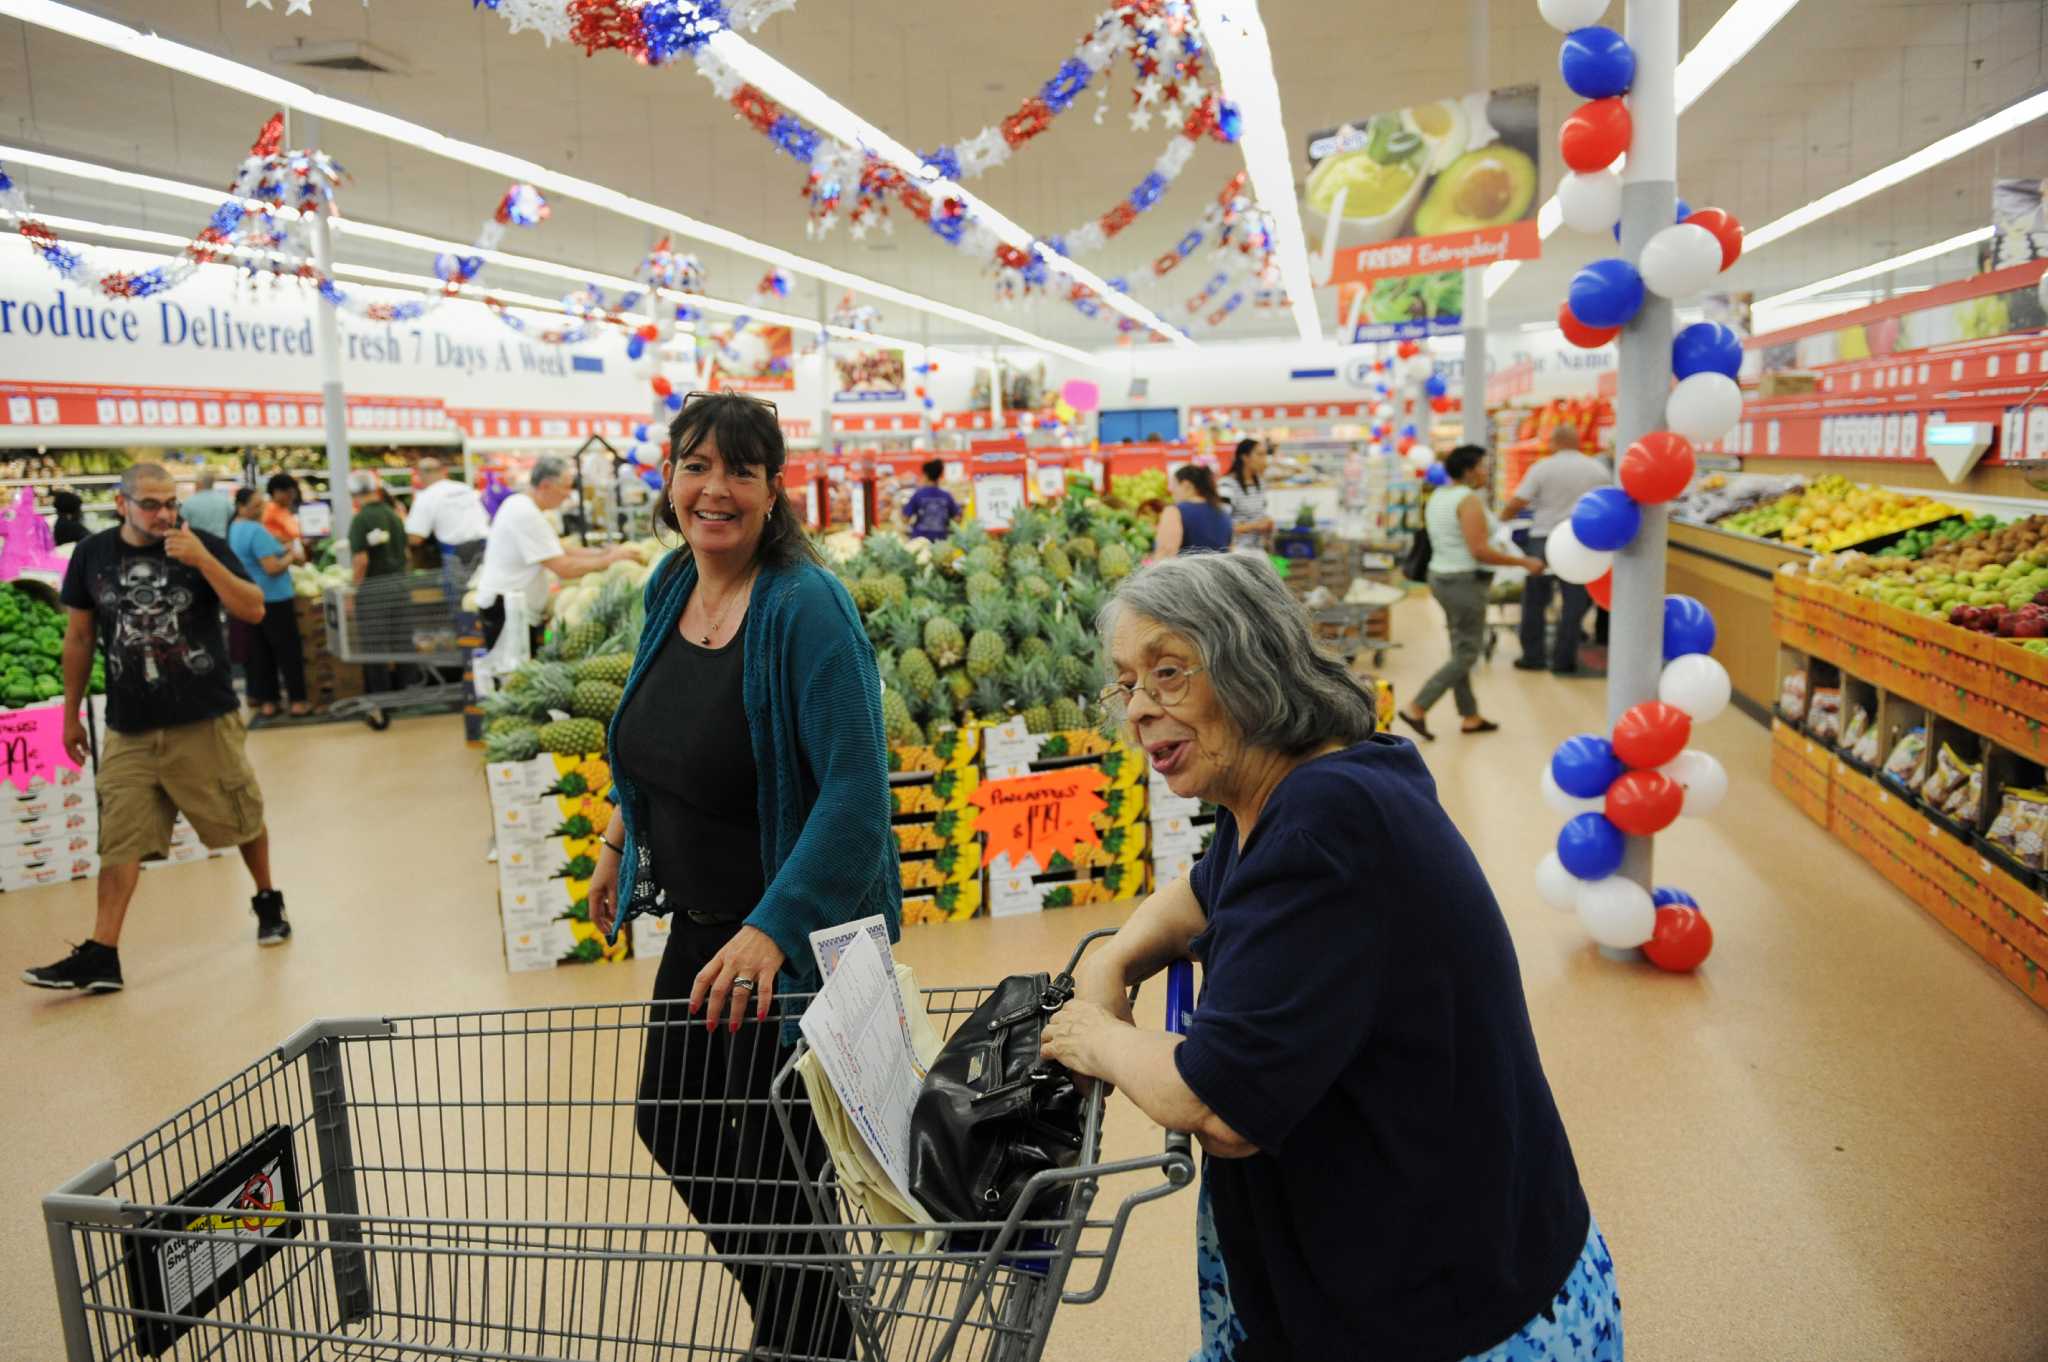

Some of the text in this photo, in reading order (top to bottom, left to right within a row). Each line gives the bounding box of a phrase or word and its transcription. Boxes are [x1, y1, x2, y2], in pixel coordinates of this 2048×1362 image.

[0, 289, 567, 378] roduce Delivered resh 7 Days A Week
